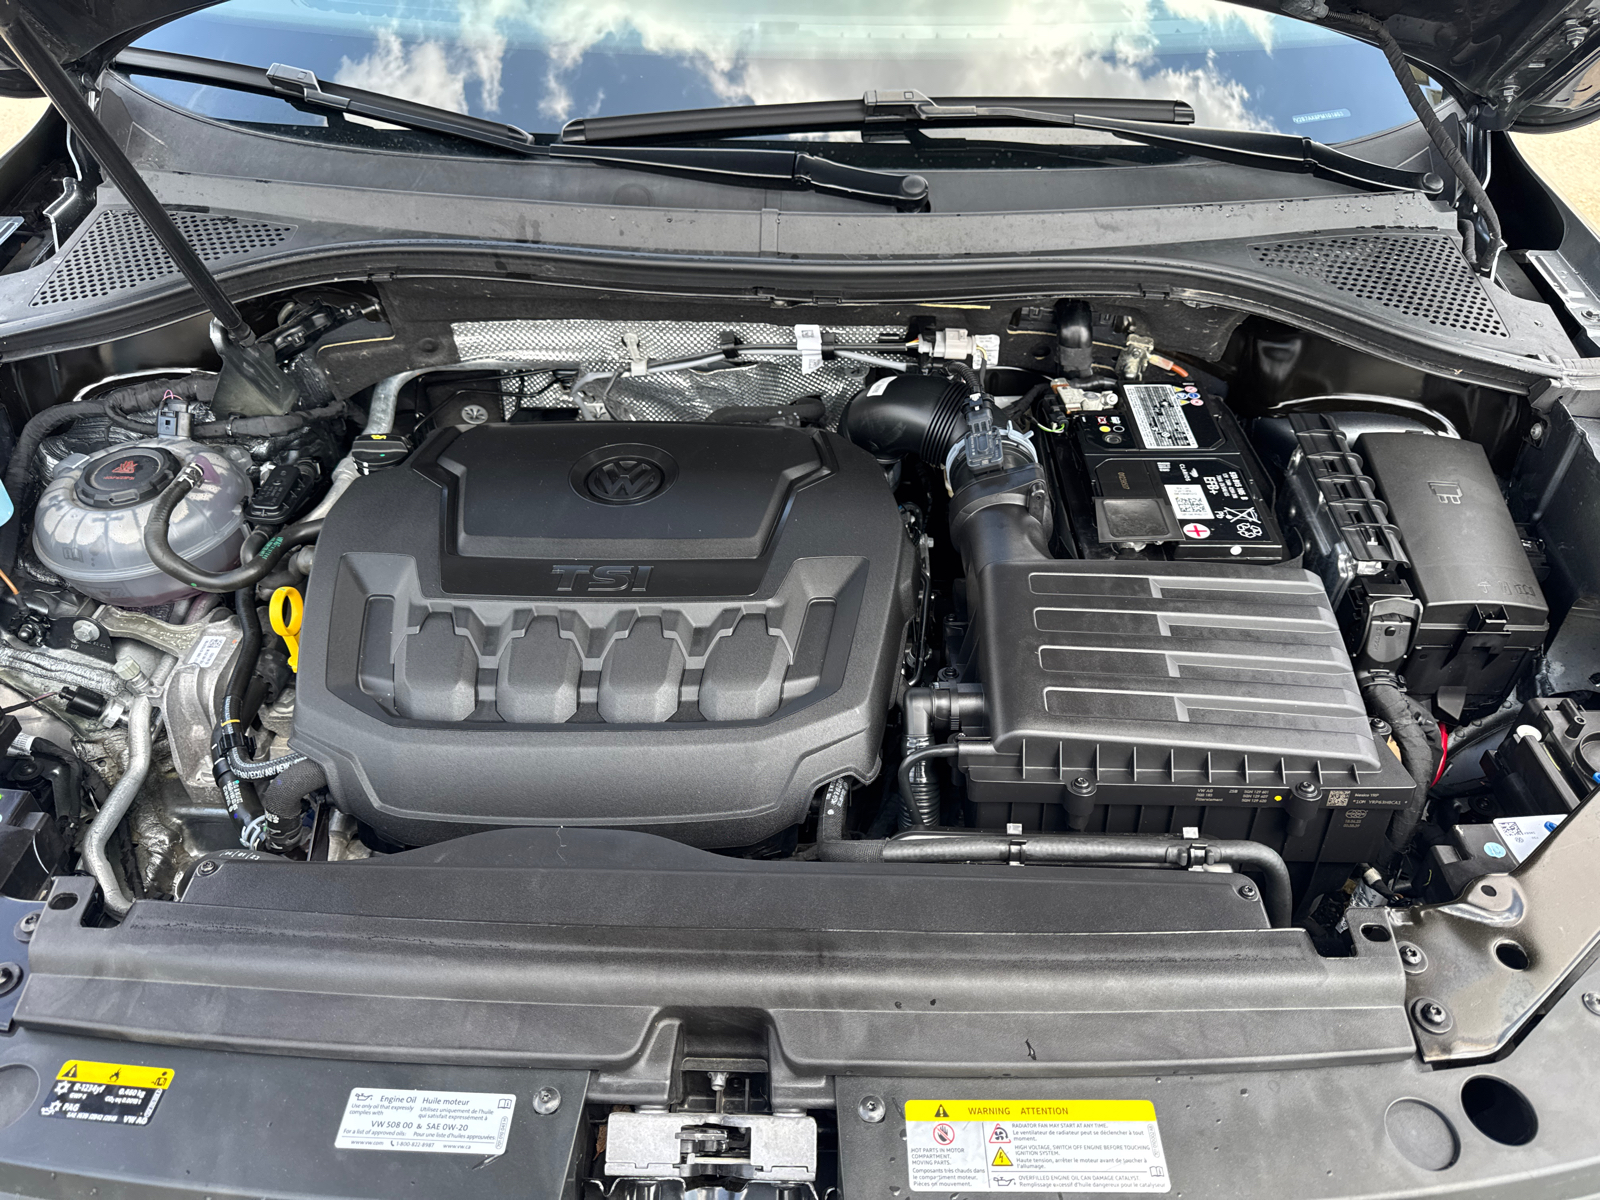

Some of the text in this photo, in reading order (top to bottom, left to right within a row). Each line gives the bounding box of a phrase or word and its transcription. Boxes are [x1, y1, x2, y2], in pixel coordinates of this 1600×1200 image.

[1179, 463, 1192, 482] CLARIOS
[1203, 476, 1220, 495] EFB+
[1214, 510, 1225, 519] Pb
[551, 564, 655, 592] TSI
[73, 1083, 106, 1096] R-1234yf
[137, 1089, 146, 1099] kg
[380, 1095, 405, 1104] Engine
[422, 1097, 470, 1106] Huile moteur
[62, 1102, 80, 1112] PAG
[968, 1107, 1011, 1116] WARNING
[1020, 1107, 1069, 1116] ATTENTION
[123, 1114, 149, 1126] VW AG
[371, 1120, 386, 1128] VW
[402, 1121, 413, 1129] 00
[426, 1122, 441, 1130] SAE
[442, 1123, 469, 1131] 0W-20
[1019, 1181, 1051, 1189] Remplissage
